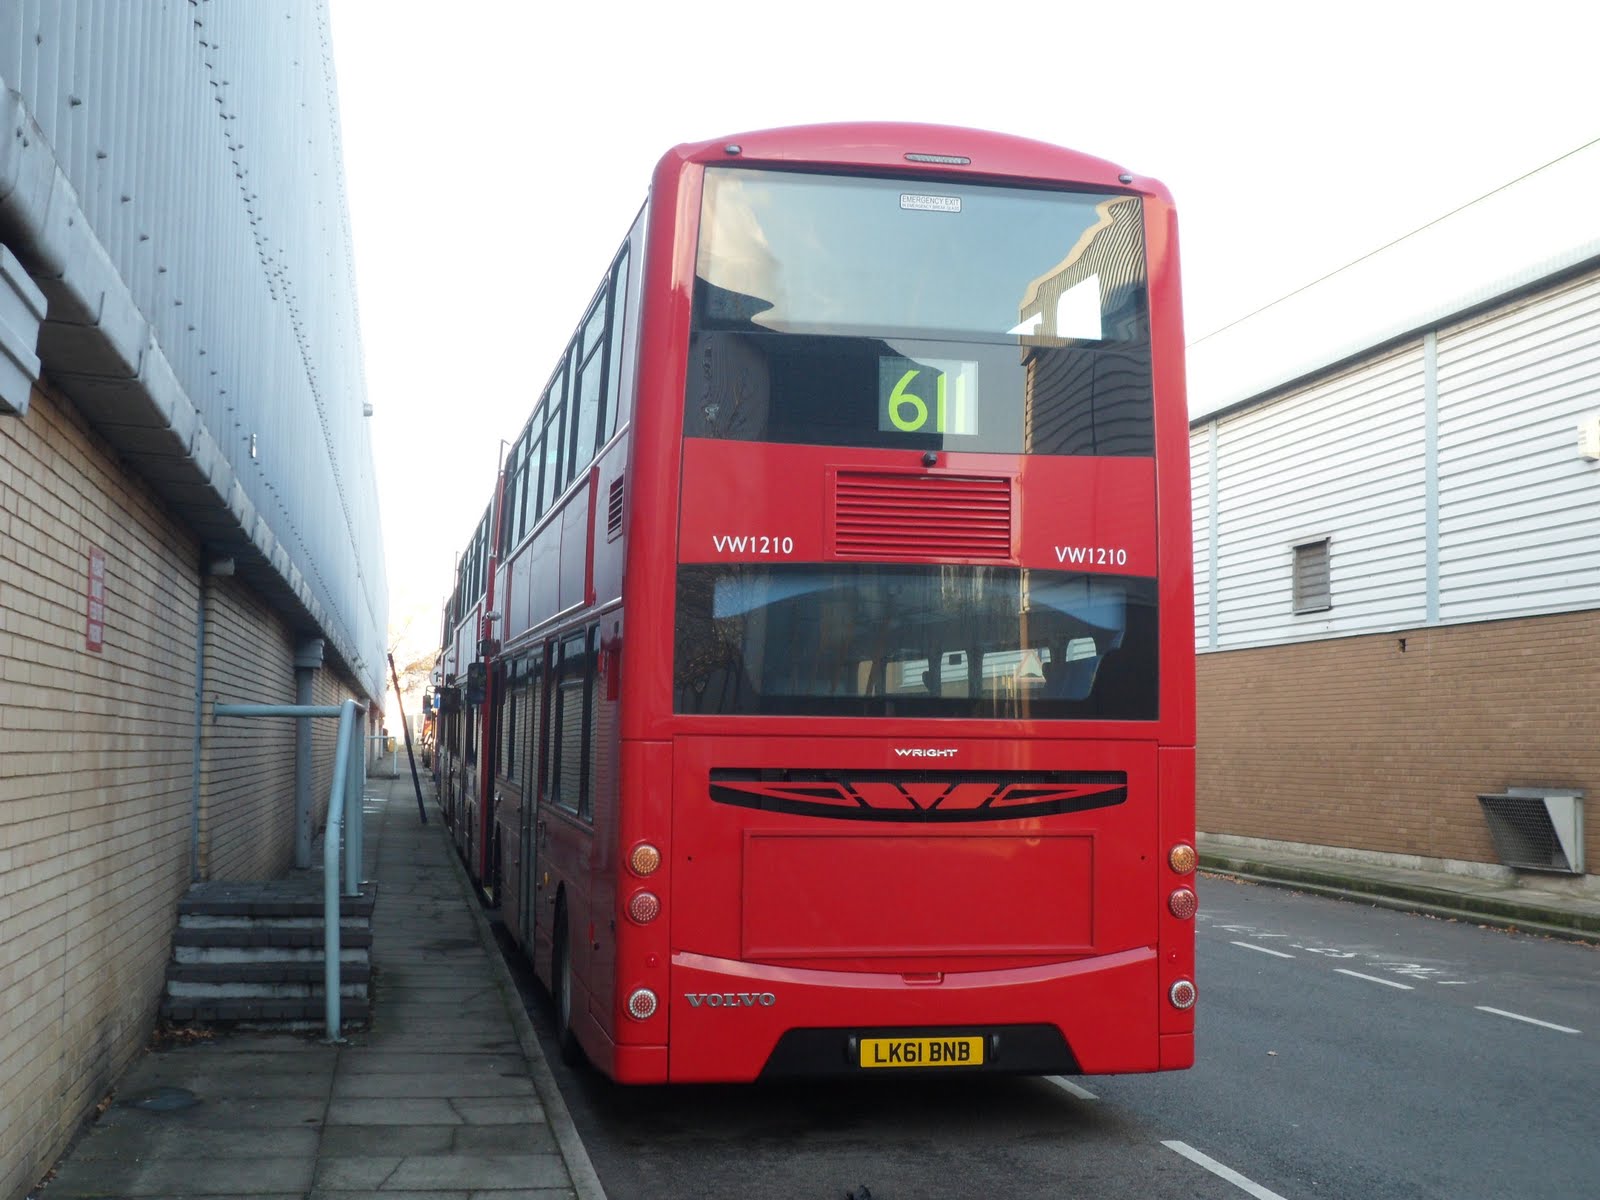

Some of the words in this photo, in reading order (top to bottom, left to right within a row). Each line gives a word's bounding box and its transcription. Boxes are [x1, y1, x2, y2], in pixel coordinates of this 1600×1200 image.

[902, 196, 943, 205] EMERGENCY
[945, 198, 959, 206] EXIT
[713, 535, 793, 554] VW1210
[1054, 546, 1127, 565] VW1210
[894, 748, 958, 757] WRIGHT
[684, 992, 776, 1008] VOLVO
[874, 1042, 922, 1063] LK61
[929, 1041, 970, 1062] BNB
